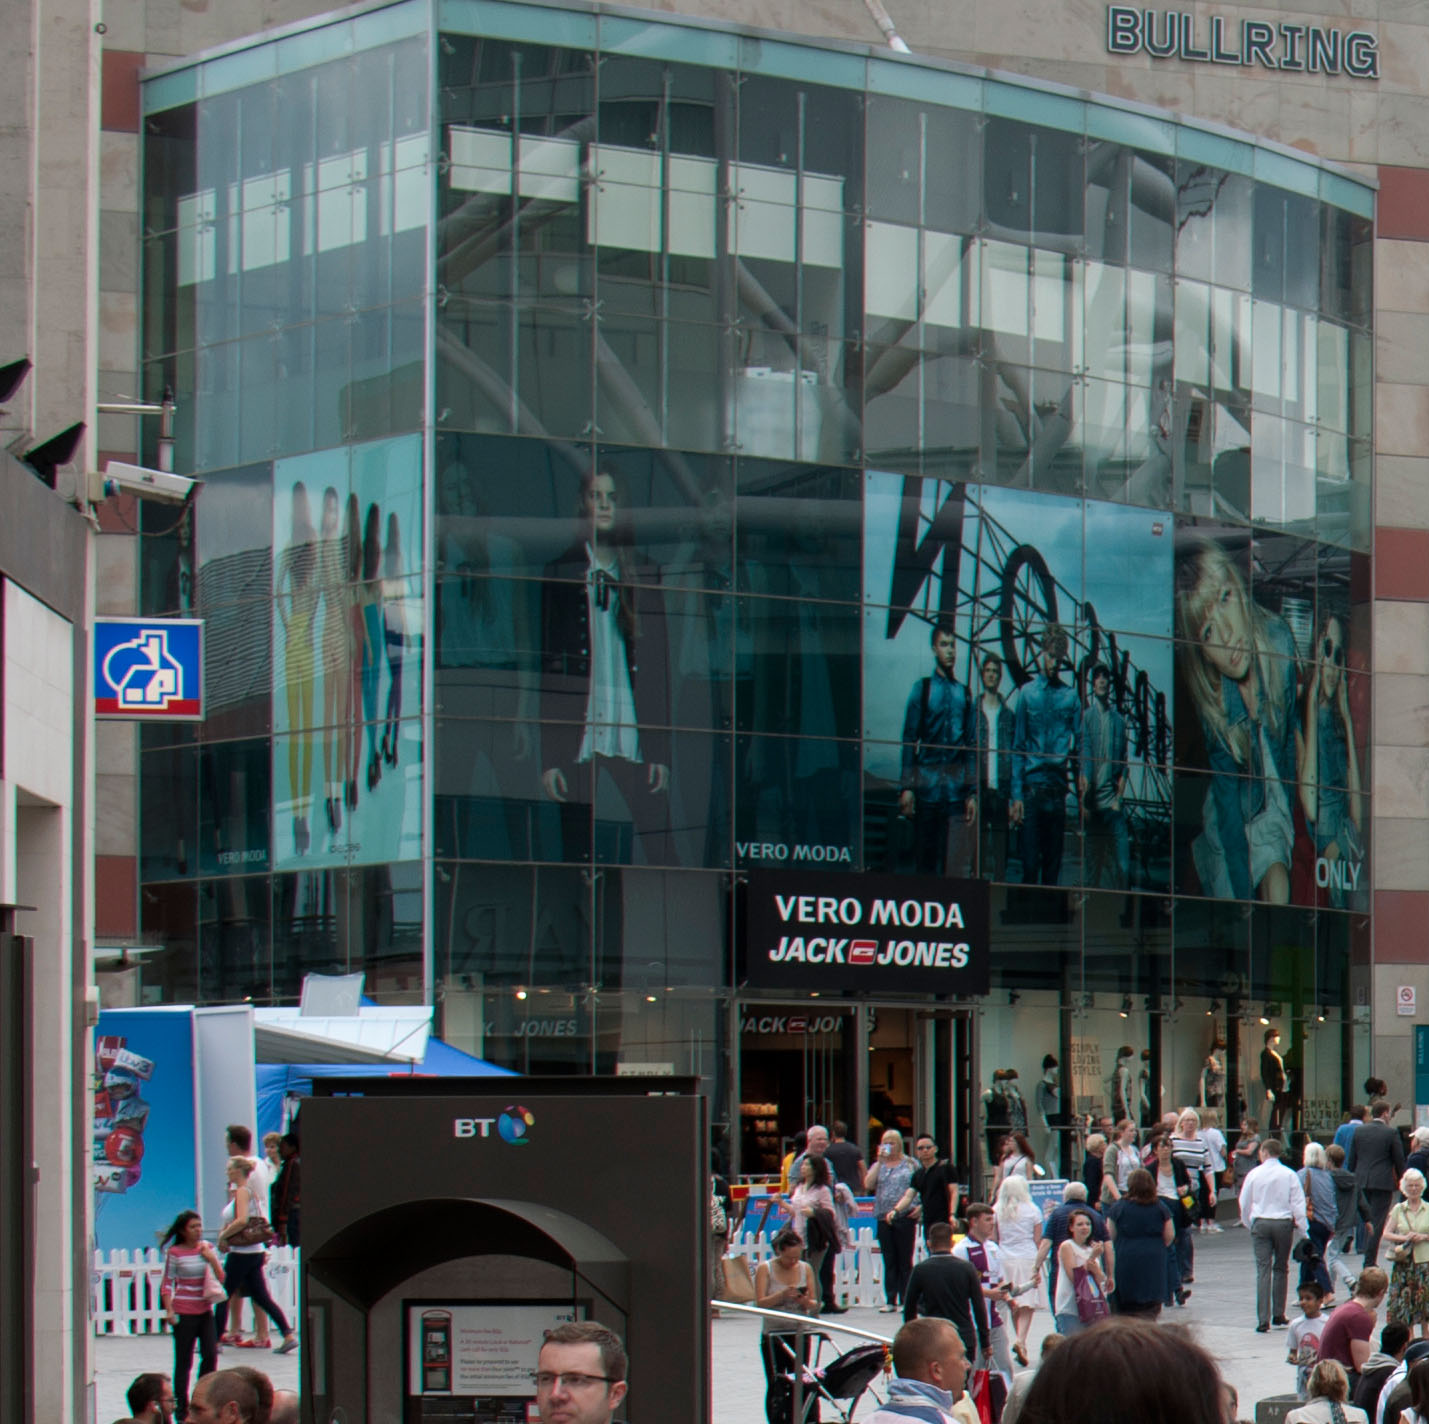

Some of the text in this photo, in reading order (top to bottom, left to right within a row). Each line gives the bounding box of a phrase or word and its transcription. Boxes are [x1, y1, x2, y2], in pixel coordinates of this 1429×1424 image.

[1106, 5, 1380, 79] BULLRING
[735, 842, 851, 862] VERO MODA
[1315, 857, 1361, 891] ONLY
[774, 895, 965, 929] VERO MODA
[768, 936, 970, 969] JACK JONES
[514, 1020, 577, 1036] JONES
[454, 1118, 496, 1138] BT
